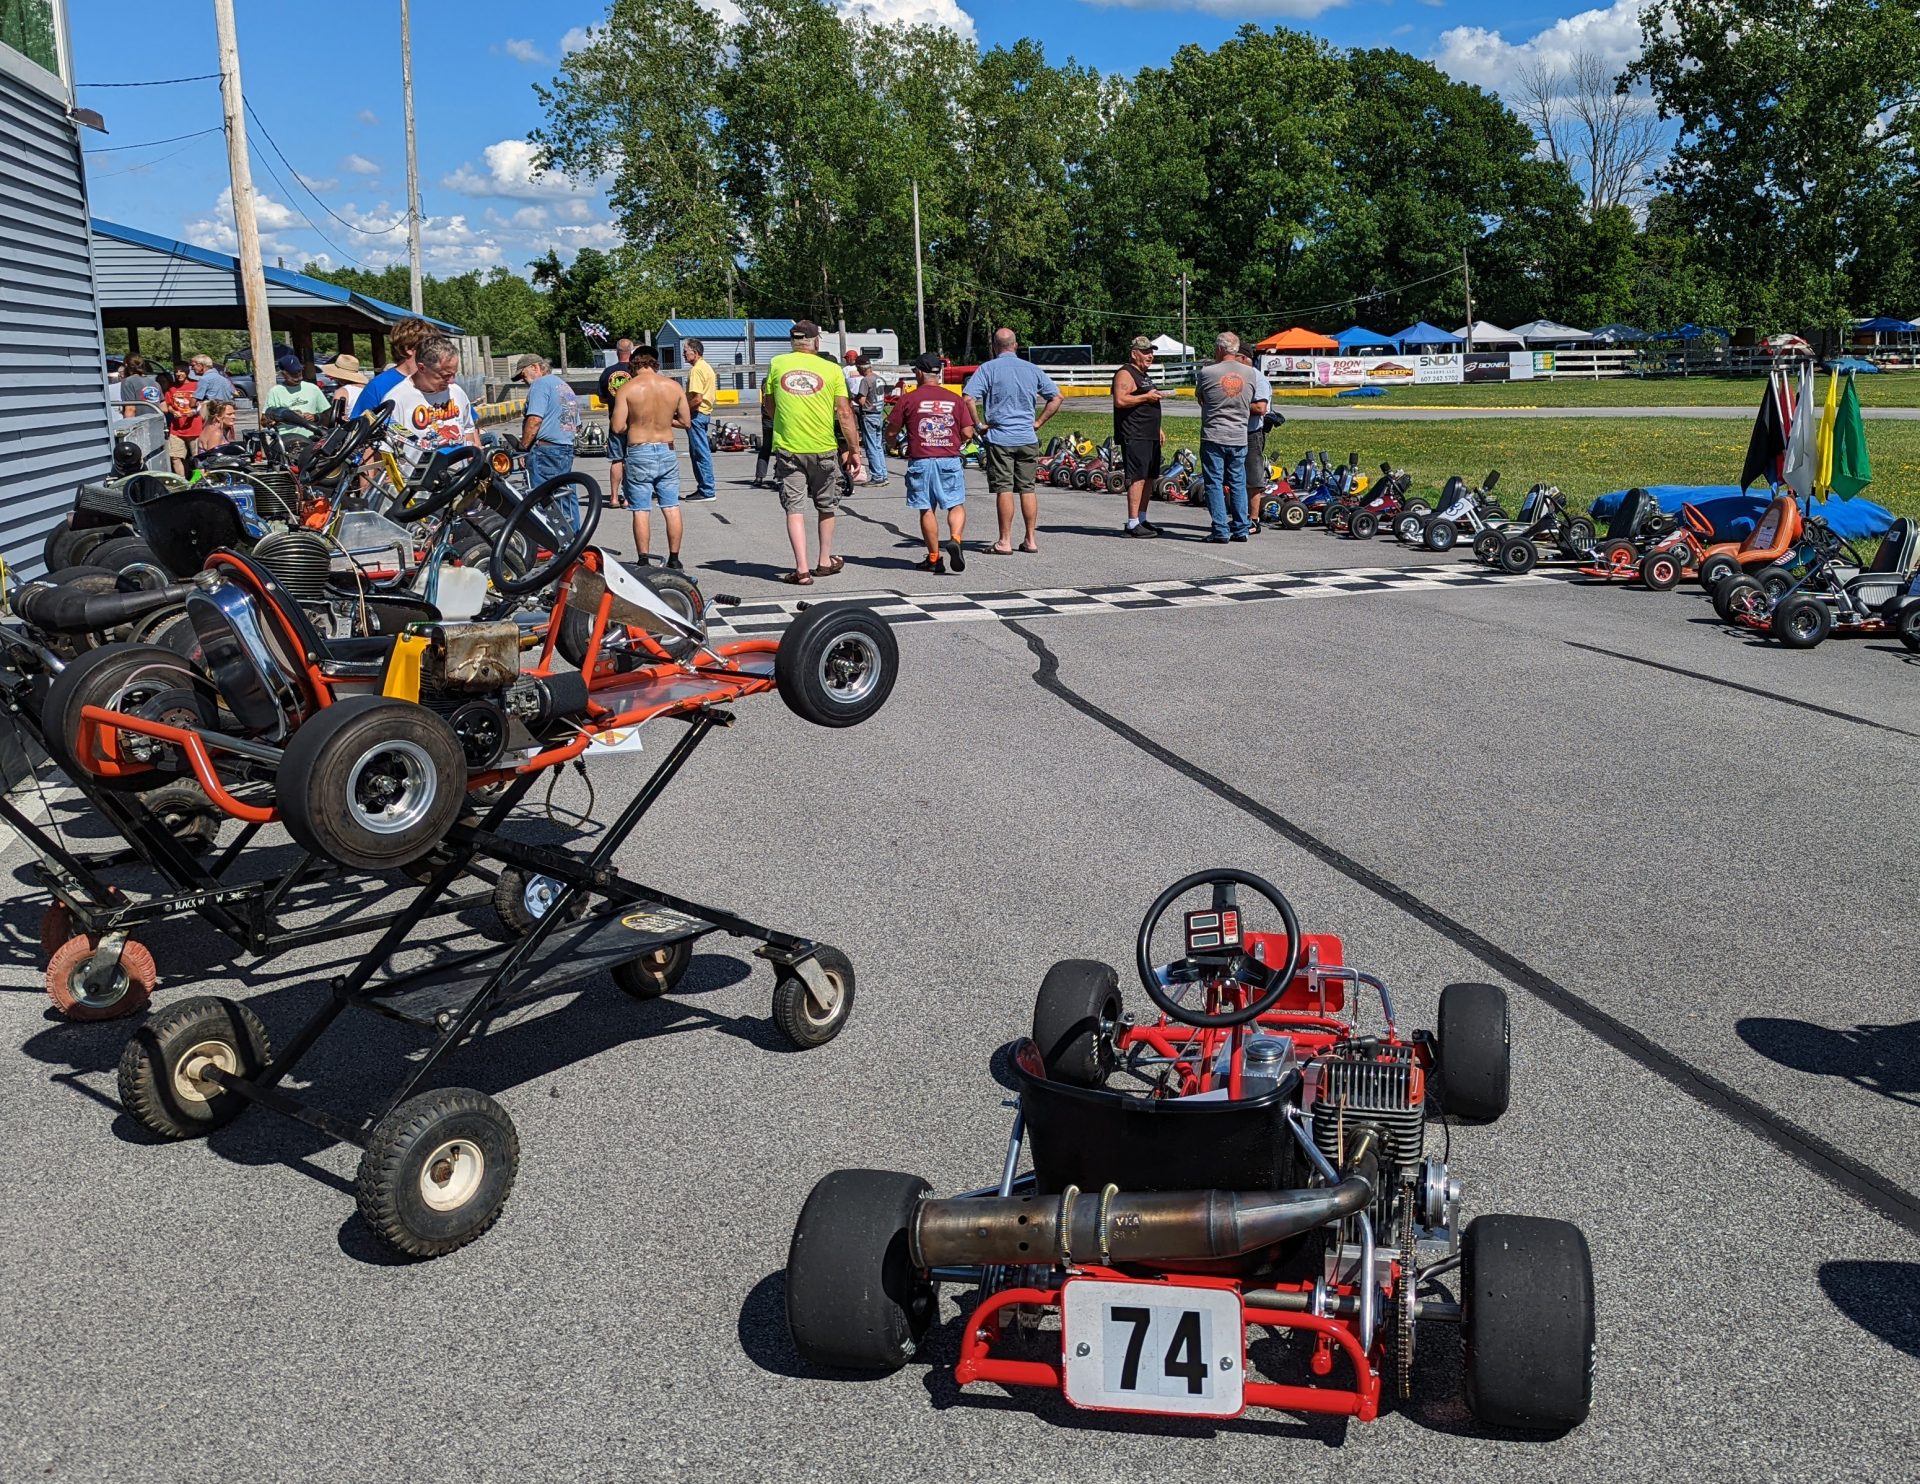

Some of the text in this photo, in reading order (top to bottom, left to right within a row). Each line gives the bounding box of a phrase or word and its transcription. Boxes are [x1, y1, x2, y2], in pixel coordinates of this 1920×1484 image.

[1333, 360, 1361, 368] BOON
[1420, 356, 1458, 366] SNOW
[1367, 369, 1413, 377] PERINTON
[175, 899, 197, 911] BLACK
[1110, 1306, 1208, 1395] 74
